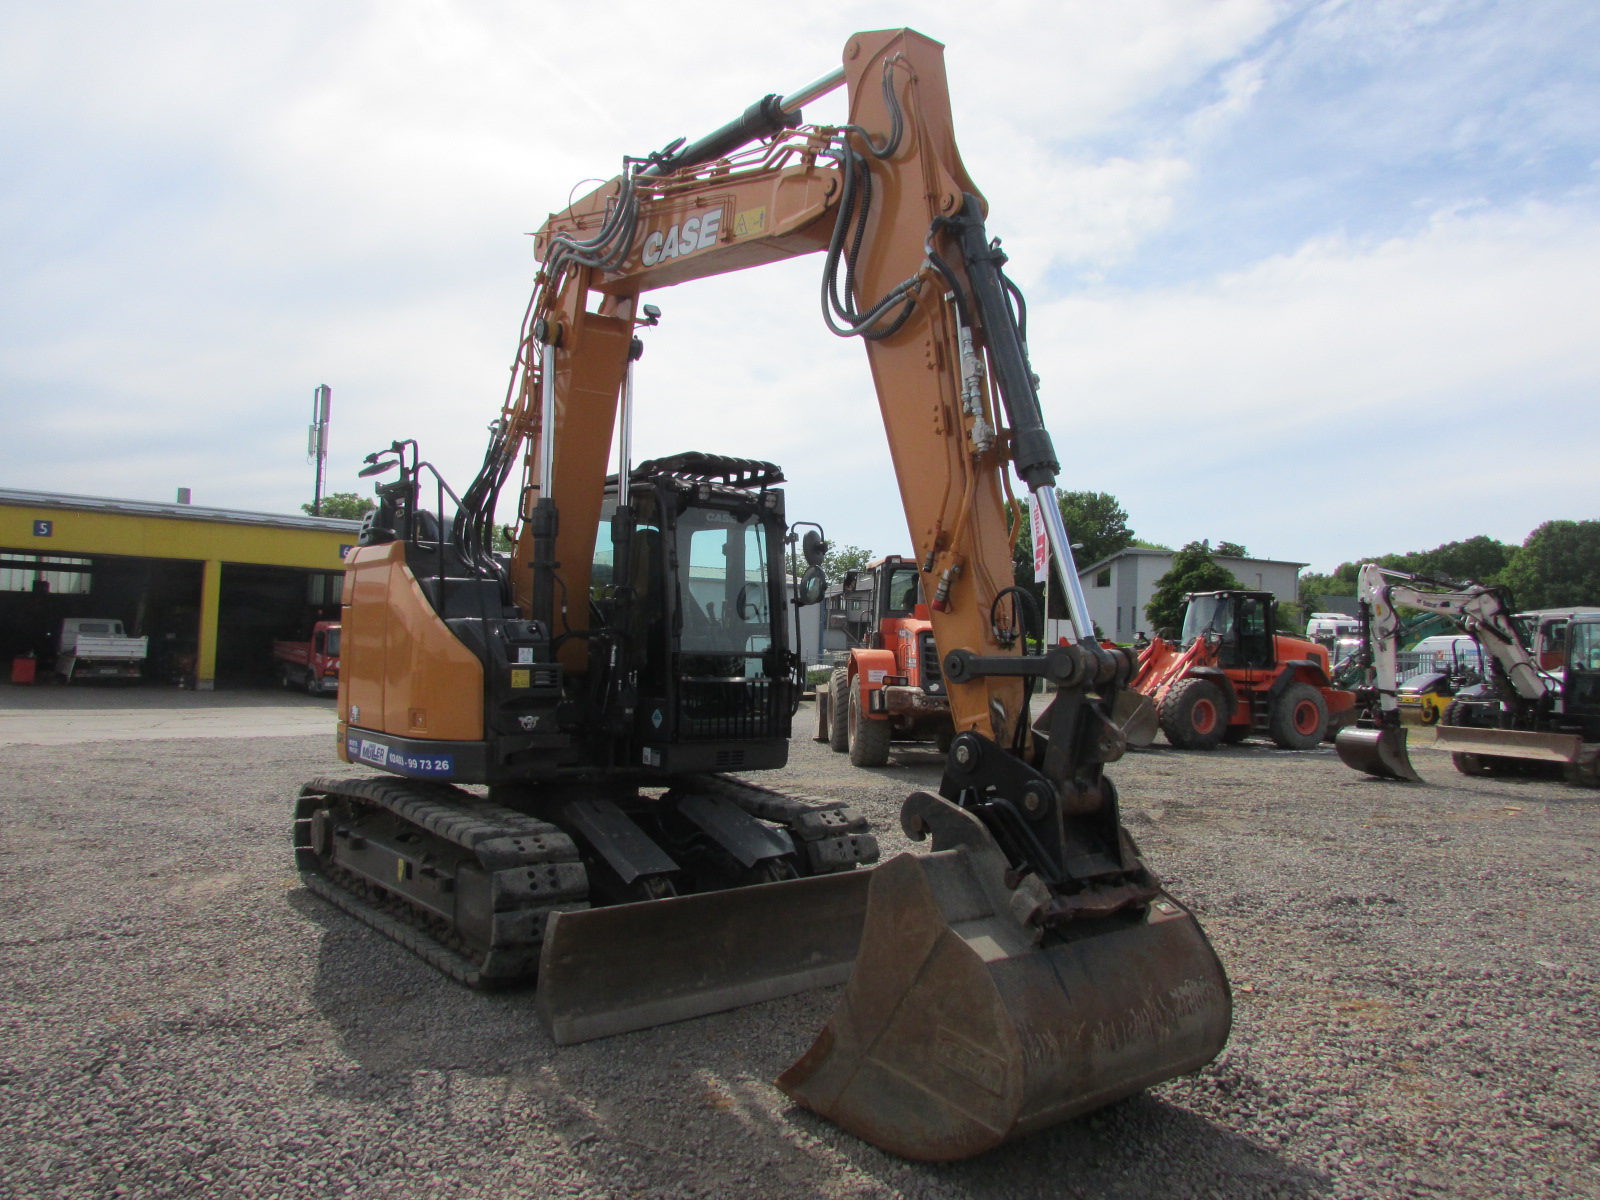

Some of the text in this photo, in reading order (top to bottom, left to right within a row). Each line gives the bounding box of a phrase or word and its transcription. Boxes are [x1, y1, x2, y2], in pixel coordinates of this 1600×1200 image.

[641, 207, 723, 267] CASE
[706, 512, 738, 524] CASE
[39, 522, 48, 534] 5
[408, 758, 418, 769] 99
[420, 760, 432, 770] 73
[435, 760, 450, 771] 26
